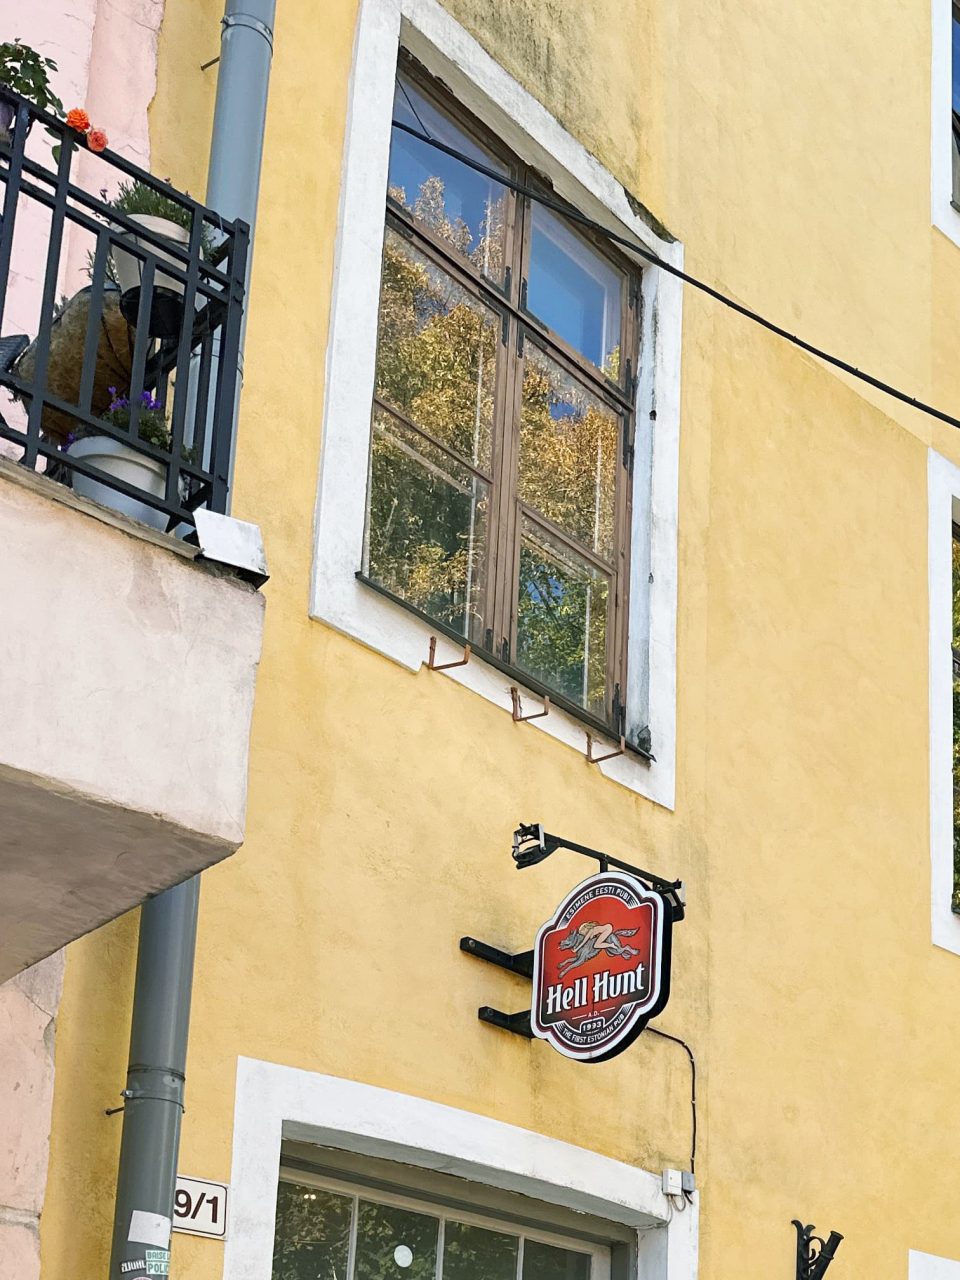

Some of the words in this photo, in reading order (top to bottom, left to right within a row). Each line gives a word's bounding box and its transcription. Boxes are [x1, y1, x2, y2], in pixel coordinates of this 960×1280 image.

[565, 891, 595, 919] ESIMENE
[595, 886, 615, 896] EESTI
[616, 888, 631, 902] PUBI
[546, 976, 588, 1015] Hell
[593, 963, 645, 1003] Hunt
[562, 1029, 573, 1041] THE
[572, 1033, 587, 1043] FIRST
[587, 1024, 615, 1043] ESTONIAN
[614, 1013, 626, 1028] PUB
[582, 1021, 603, 1031] 1993
[587, 1010, 600, 1018] A.D.
[174, 1189, 219, 1224] 9/1
